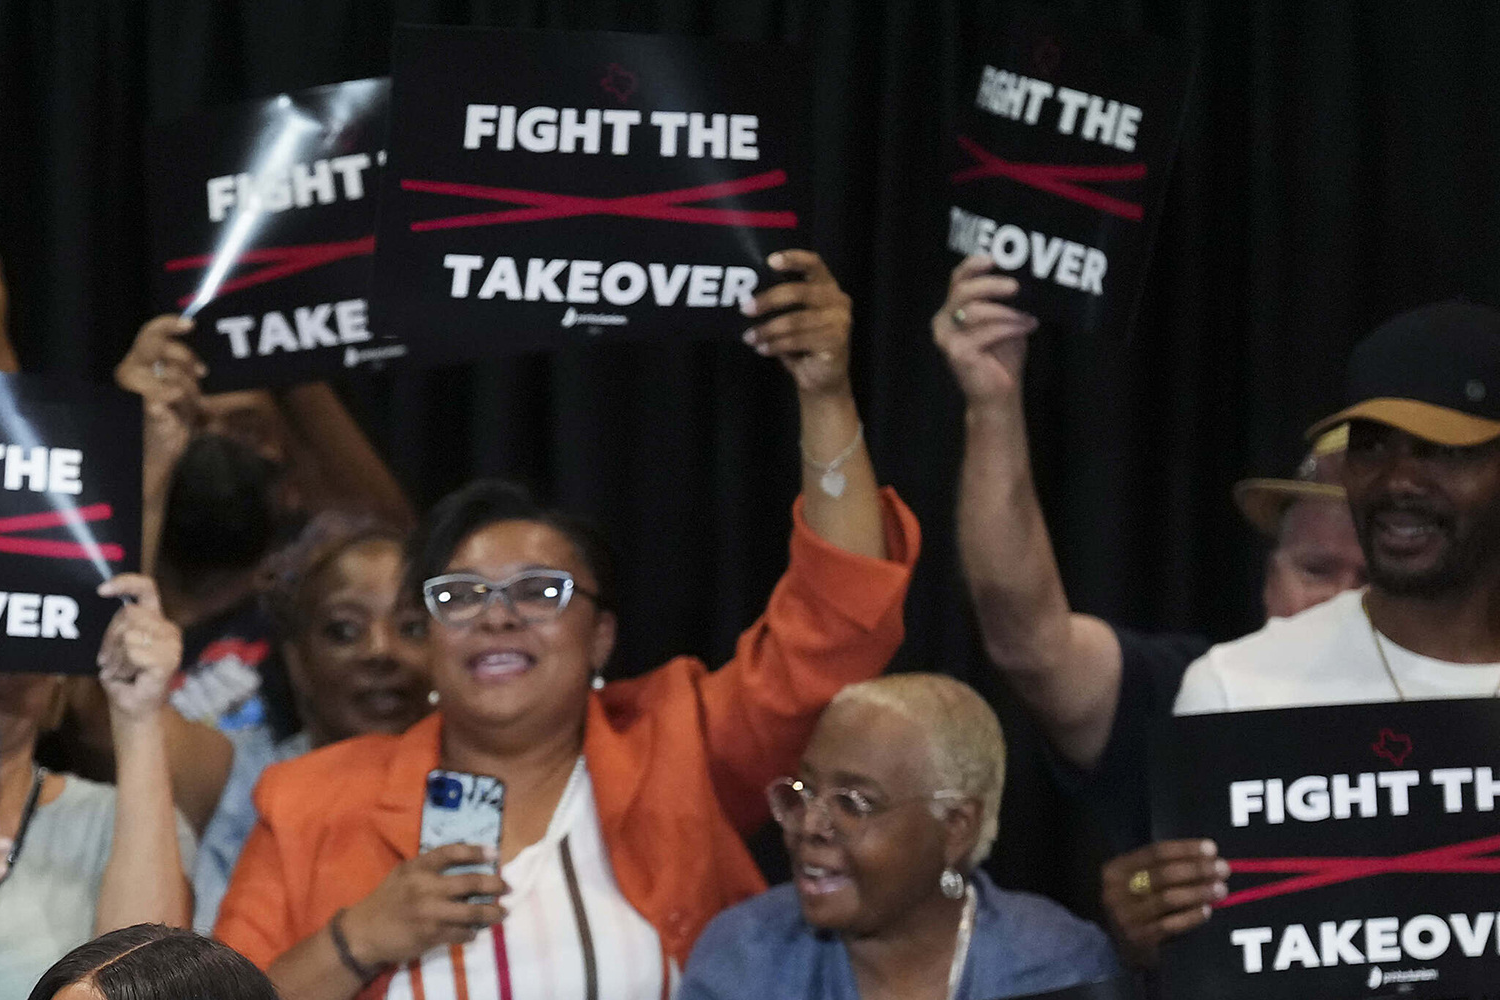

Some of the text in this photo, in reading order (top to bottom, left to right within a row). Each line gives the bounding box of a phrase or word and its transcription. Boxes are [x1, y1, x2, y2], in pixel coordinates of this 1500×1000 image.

[463, 103, 760, 161] FIGHT THE
[1056, 86, 1144, 152] THE
[443, 253, 760, 309] TAKEOVER
[948, 205, 1108, 296] EOVER
[215, 297, 374, 359] TAKE
[1229, 766, 1500, 828] FIGHT TH
[1230, 911, 1500, 974] TAKEOV
